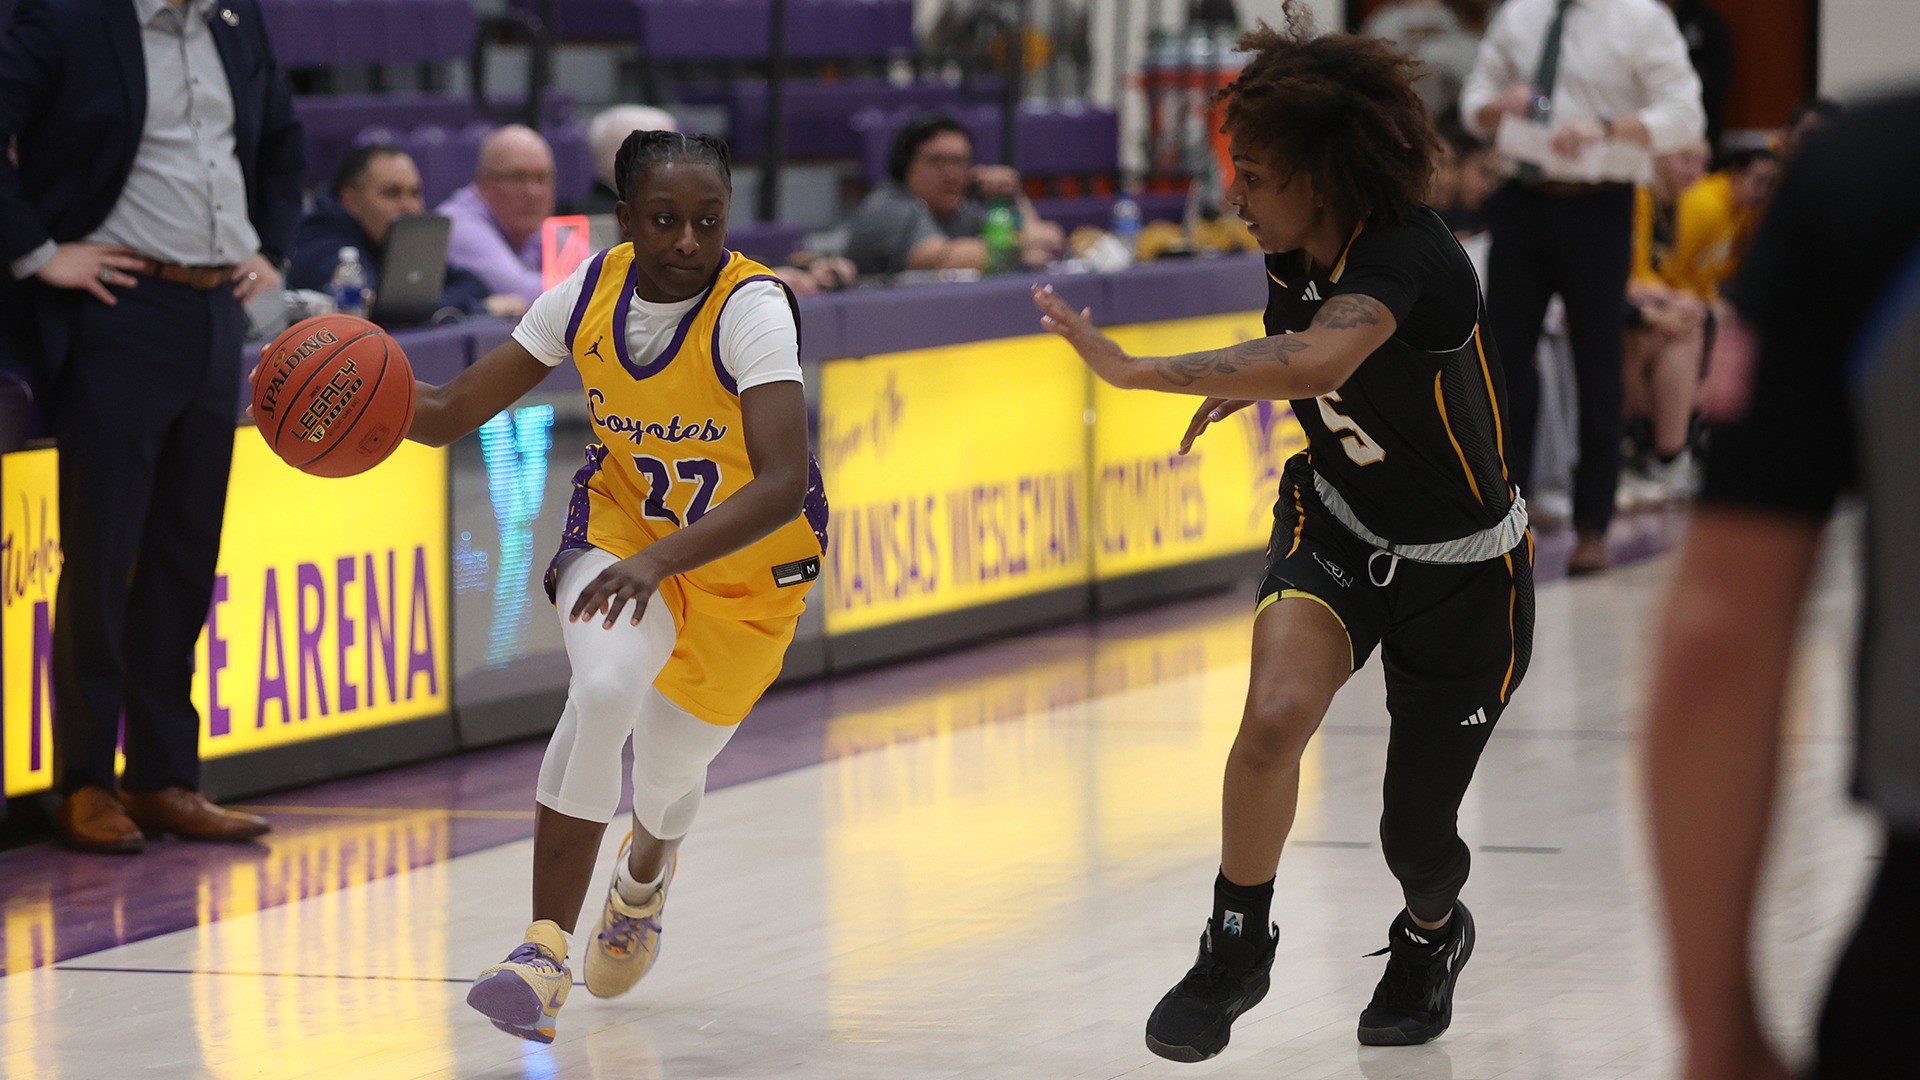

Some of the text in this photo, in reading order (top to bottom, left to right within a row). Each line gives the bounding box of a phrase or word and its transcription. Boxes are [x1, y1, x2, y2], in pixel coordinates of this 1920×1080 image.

[261, 327, 339, 419] SPALDING
[291, 358, 358, 441] LEGACY
[322, 377, 363, 428] 1000
[588, 387, 728, 445] Coyotes
[1315, 390, 1387, 467] 5
[806, 563, 816, 574] M
[831, 496, 939, 610] KANSAS
[255, 545, 438, 729] ARENA
